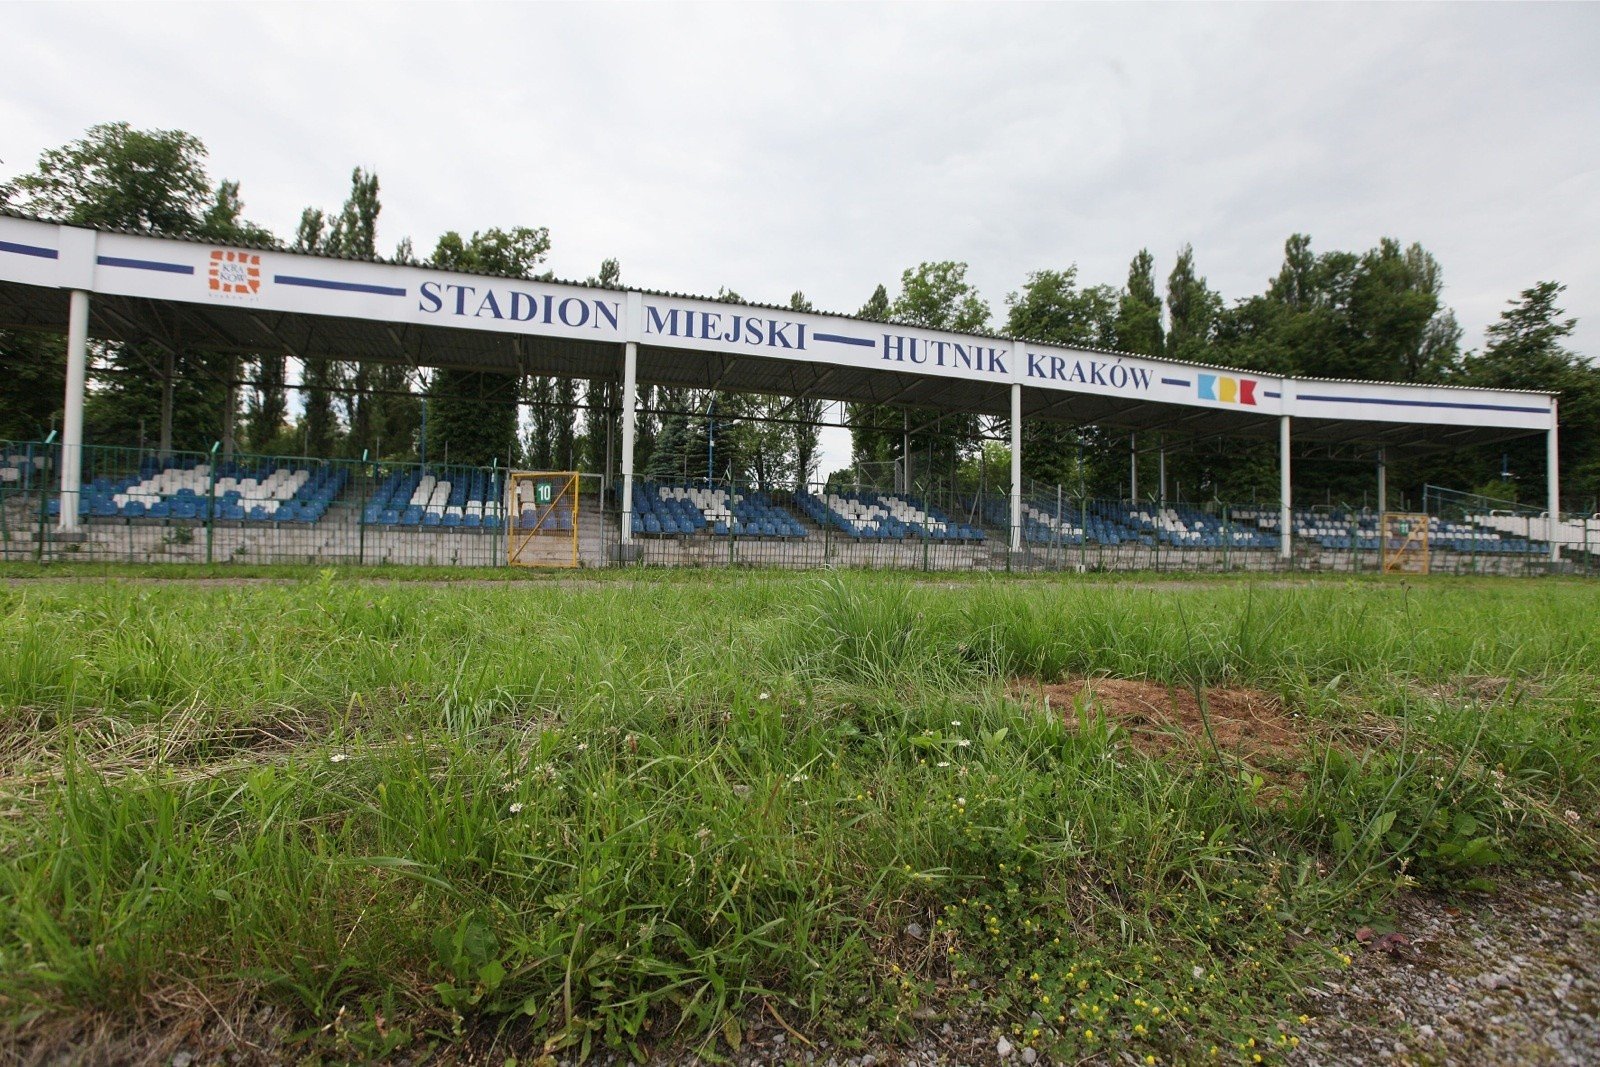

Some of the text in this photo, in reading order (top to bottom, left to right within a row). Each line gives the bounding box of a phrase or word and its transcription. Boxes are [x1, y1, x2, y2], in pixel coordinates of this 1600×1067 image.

[418, 281, 808, 351] STADION MIEJSKI
[881, 333, 1154, 391] HUTNIK KRAKÓW
[538, 485, 551, 501] 10
